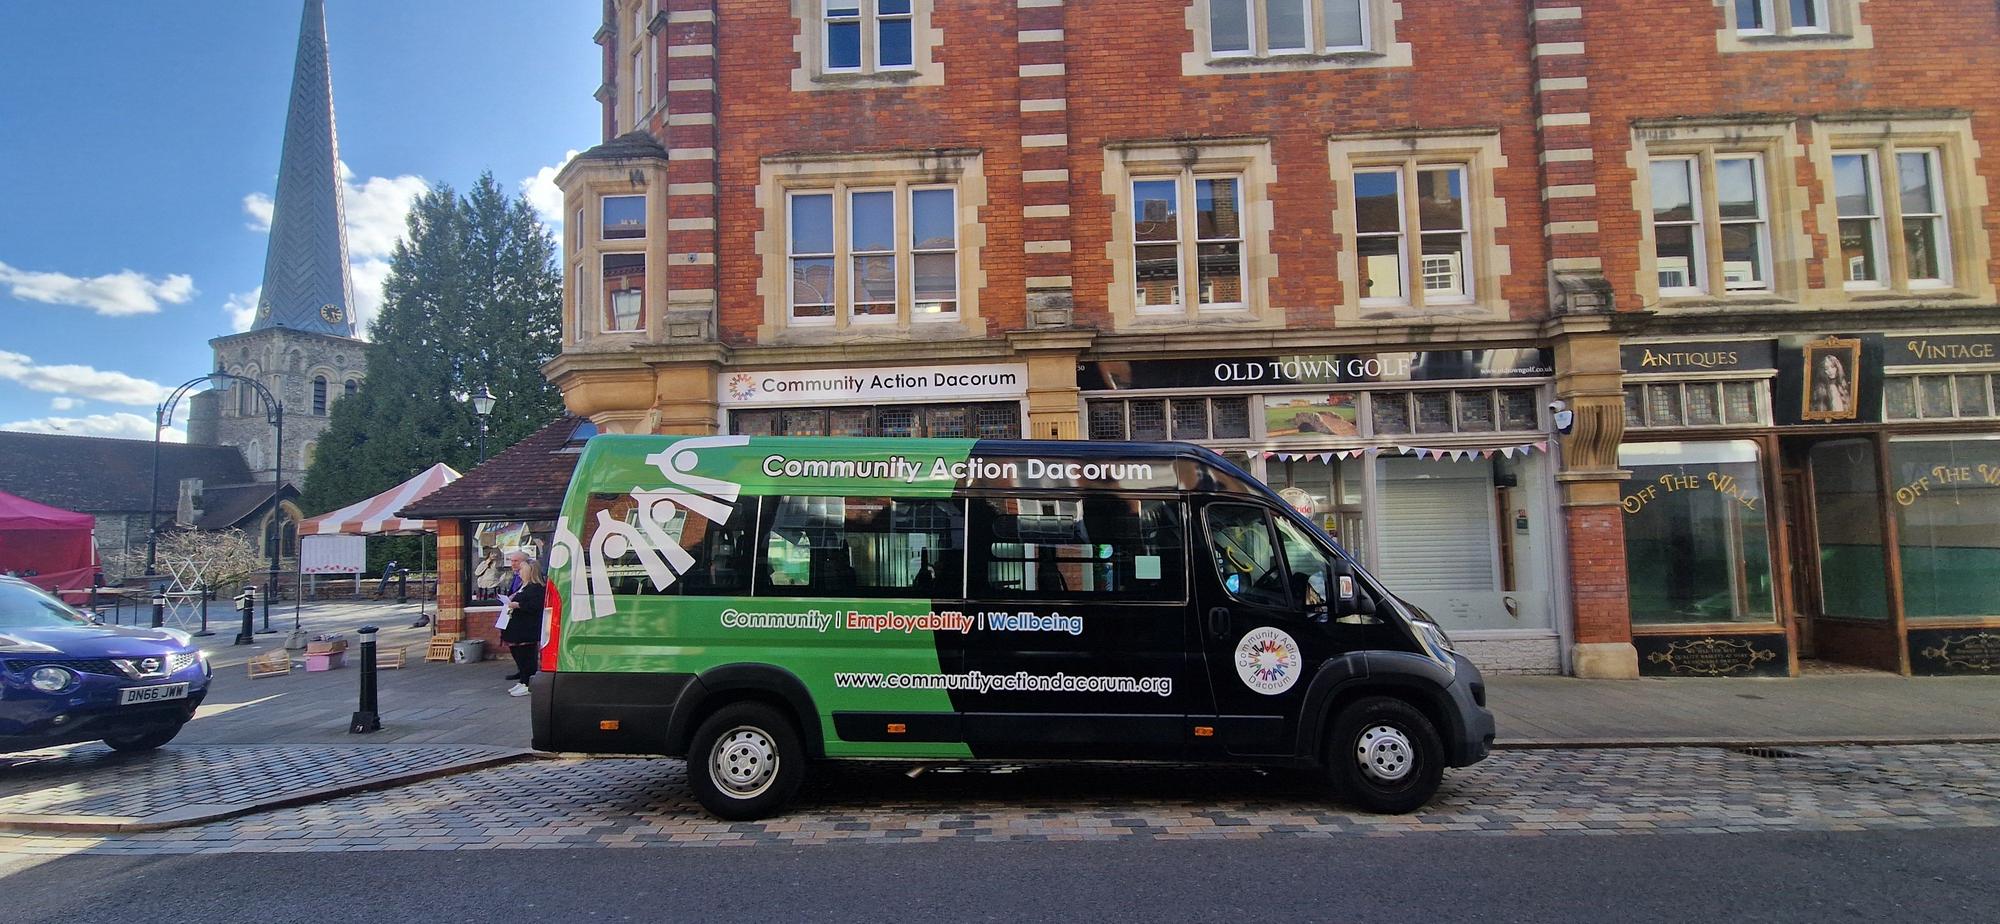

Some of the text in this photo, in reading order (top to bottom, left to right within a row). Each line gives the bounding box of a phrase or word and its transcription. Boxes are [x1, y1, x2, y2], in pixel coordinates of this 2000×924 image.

[1641, 349, 1738, 368] ANTIQUES
[1908, 341, 1995, 359] VINTAGE
[762, 372, 1017, 393] Community Action Dacorum
[1214, 358, 1411, 382] OLD TOWN GOLF
[761, 454, 1153, 484] Community Action Dacorum
[1623, 471, 1759, 514] OFF THE WALL
[1896, 476, 1930, 506] OFF
[1932, 465, 1972, 484] THE
[720, 608, 833, 632] Community
[846, 610, 974, 633] Employability
[988, 611, 1083, 634] Wellbeing
[1238, 630, 1297, 668] Community Action
[127, 685, 184, 702] DN66 JWW
[834, 670, 1173, 697] www.communityactiondacorum.org
[1248, 674, 1292, 690] Dacorum
